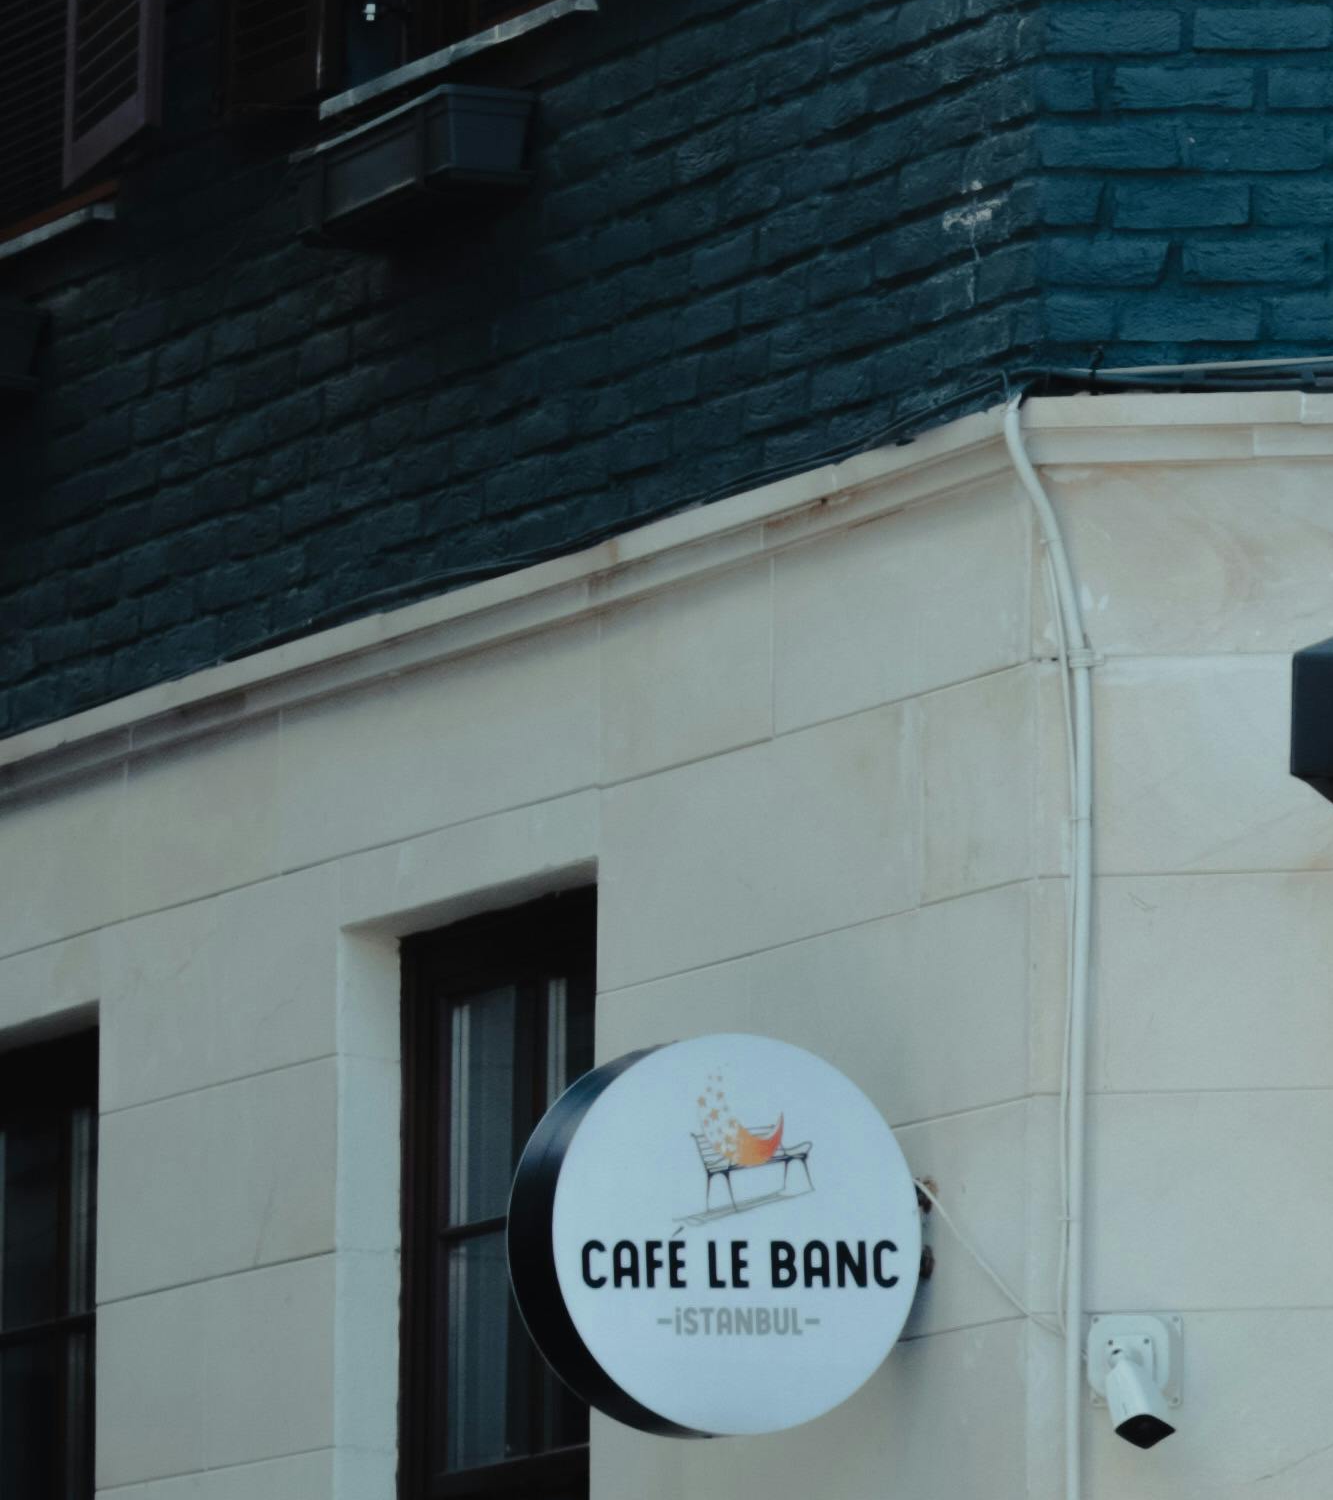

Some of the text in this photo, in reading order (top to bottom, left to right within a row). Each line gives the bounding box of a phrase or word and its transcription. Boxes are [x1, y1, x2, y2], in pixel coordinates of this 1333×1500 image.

[581, 1226, 899, 1289] CAFÉ LE BANC
